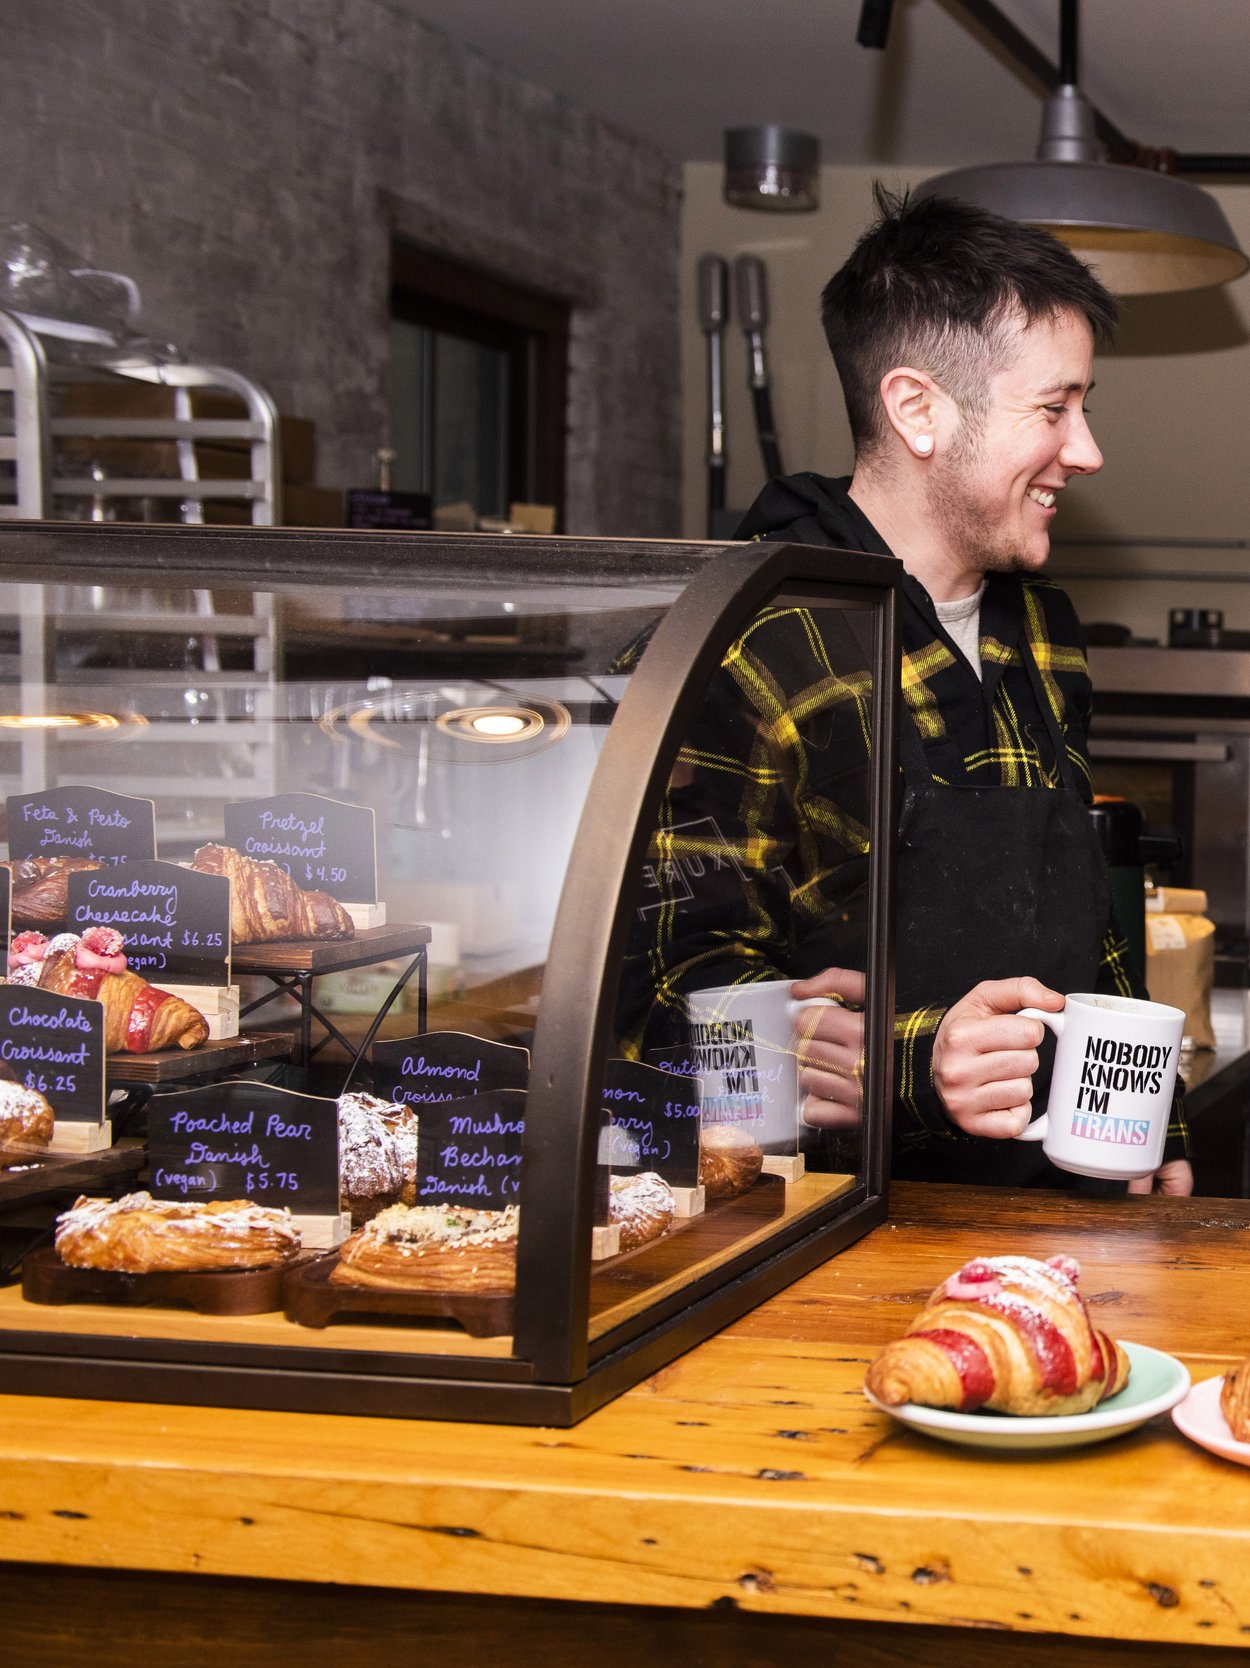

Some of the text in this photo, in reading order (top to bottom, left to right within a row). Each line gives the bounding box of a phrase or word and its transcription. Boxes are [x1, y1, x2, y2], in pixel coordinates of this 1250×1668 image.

[23, 803, 131, 828] Feta & Pesto
[259, 811, 325, 842] Pretzel
[40, 828, 93, 848] Danish
[245, 837, 326, 859] Croissant
[305, 863, 347, 882] $4.50
[88, 879, 177, 915] Cranberry
[75, 905, 177, 926] Cheesecake
[181, 929, 223, 946] $6.25
[9, 1006, 93, 1033] Chocolate
[1, 1037, 90, 1066] Croissant
[1085, 1036, 1172, 1069] NOBODY
[24, 1069, 76, 1093] $6.25
[401, 1056, 481, 1081] Almond
[1080, 1061, 1163, 1095] KNOWS
[664, 1101, 701, 1118] $5.00
[1076, 1086, 1110, 1115] I'M
[170, 1111, 312, 1141] Poached Pear
[1073, 1111, 1148, 1145] TRANS
[184, 1142, 270, 1169] Danish
[155, 1168, 299, 1194] (vegan) $5.75
[420, 1174, 492, 1196] Danish
